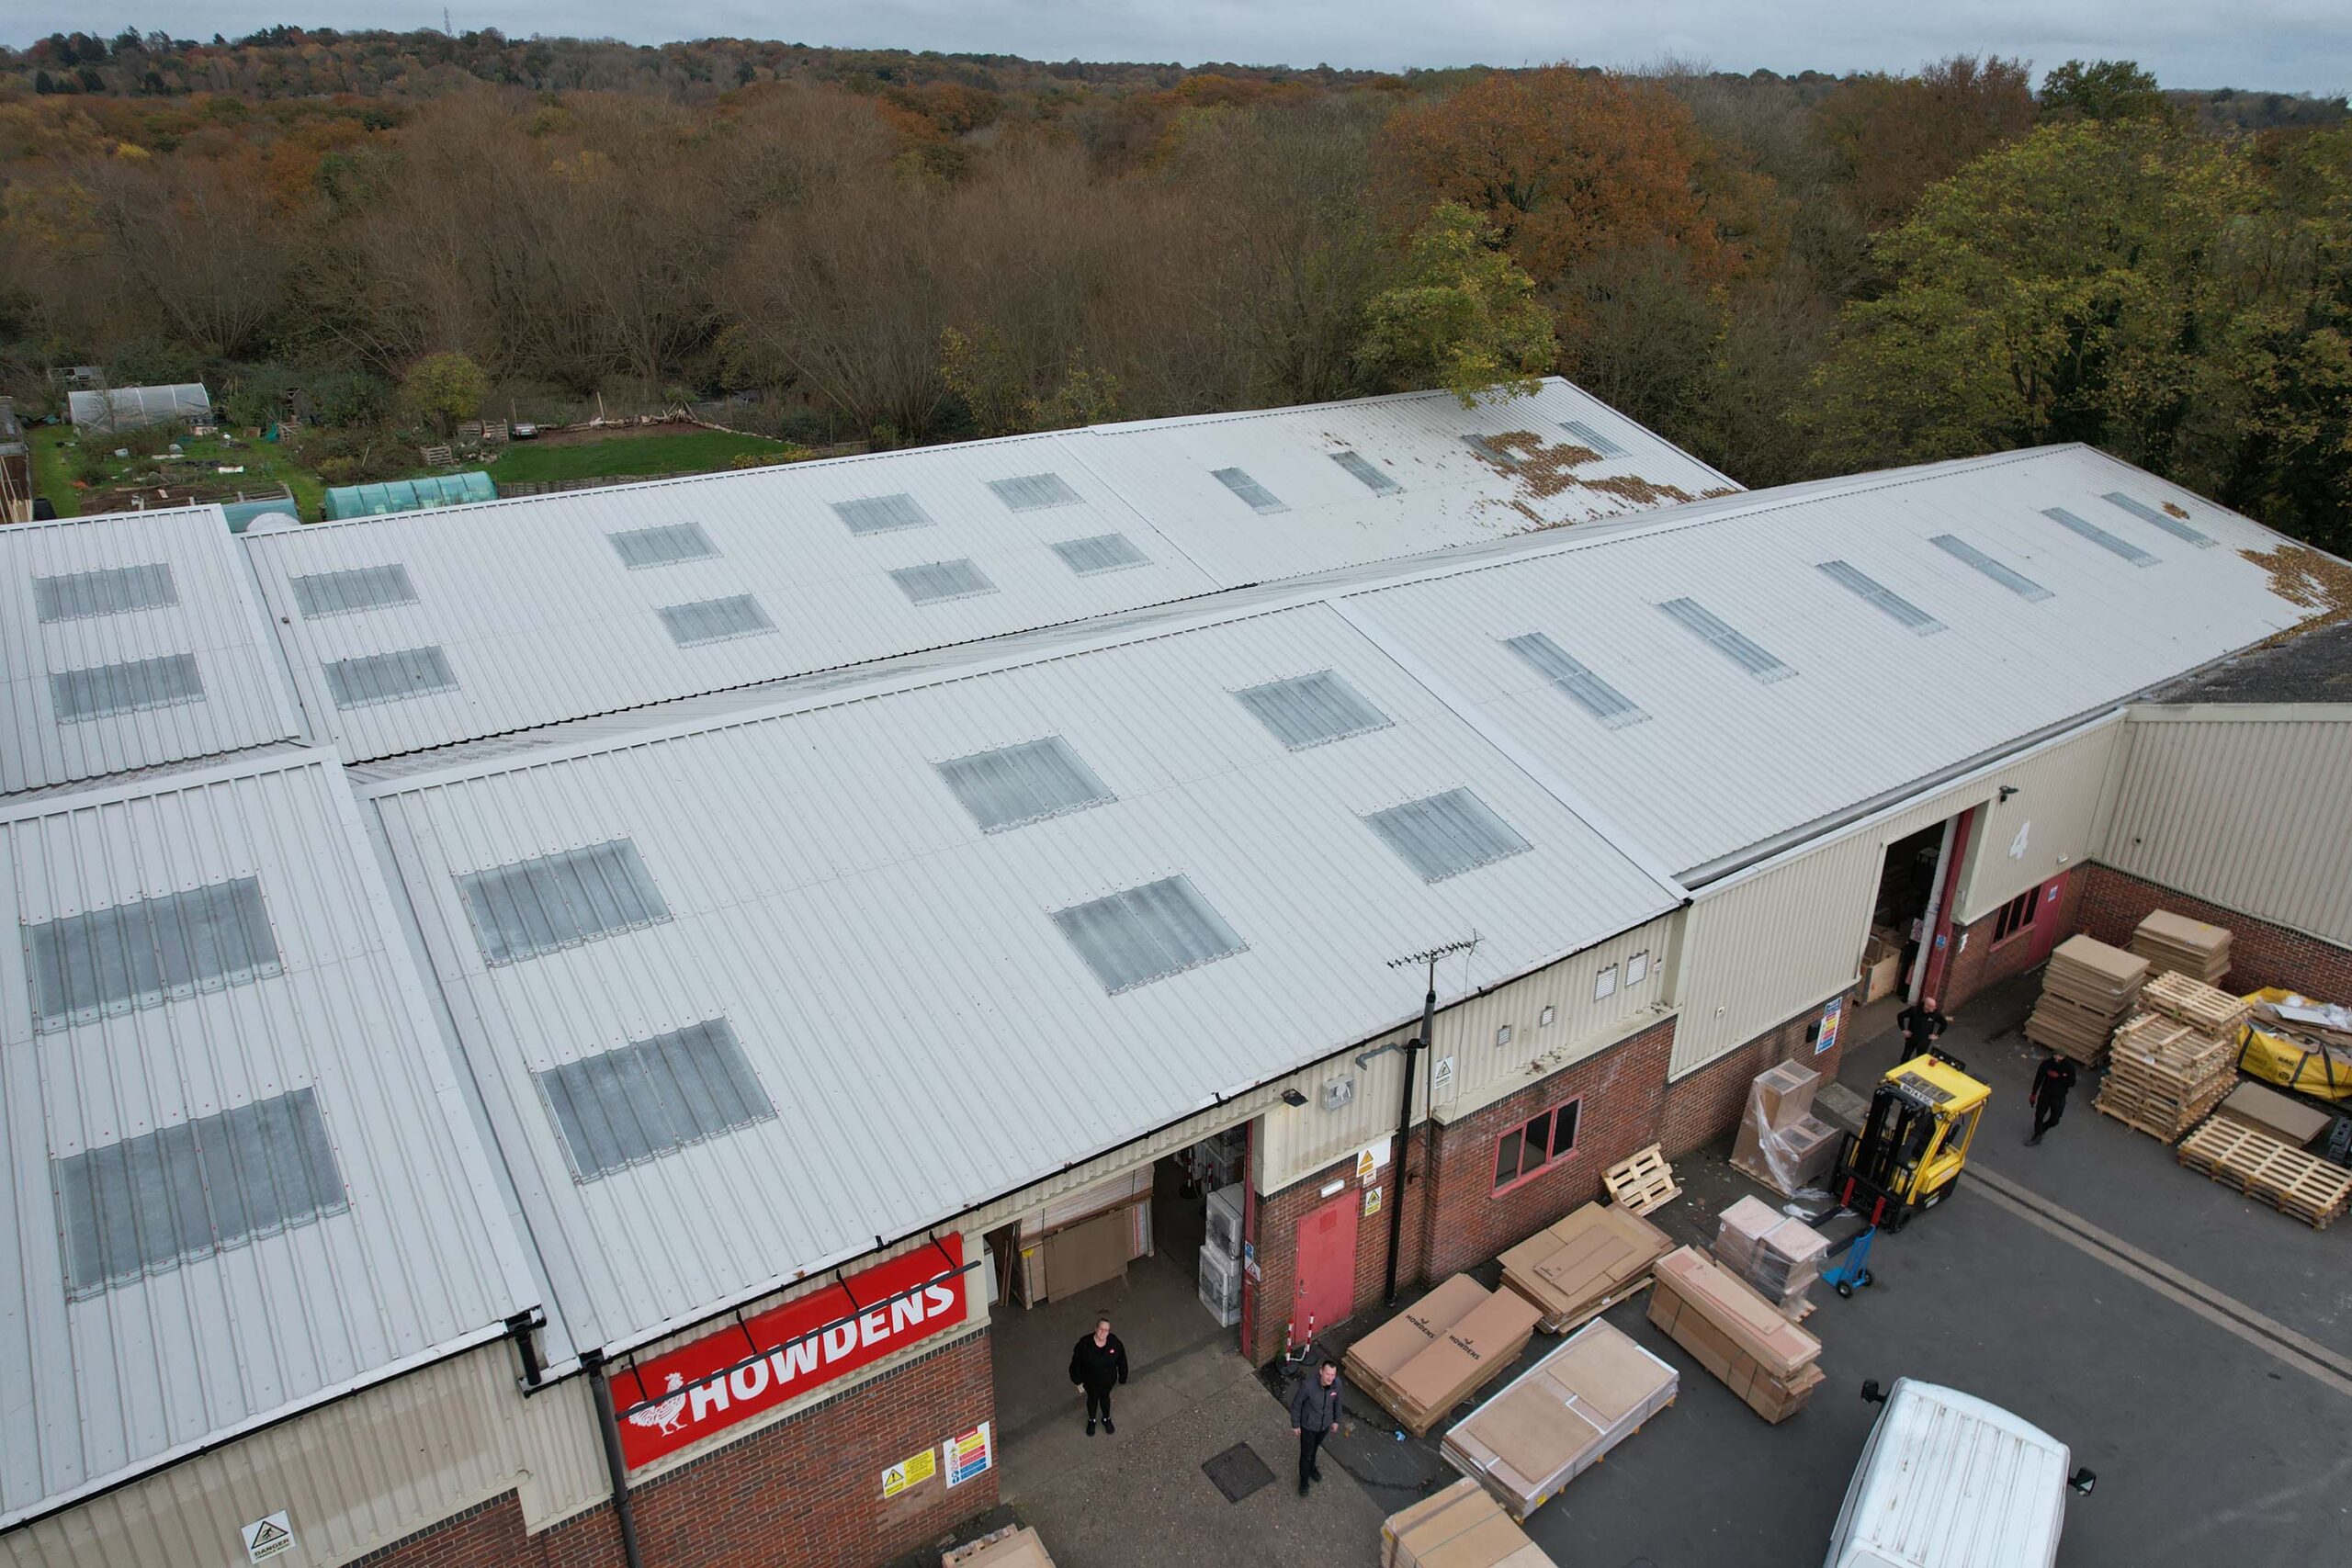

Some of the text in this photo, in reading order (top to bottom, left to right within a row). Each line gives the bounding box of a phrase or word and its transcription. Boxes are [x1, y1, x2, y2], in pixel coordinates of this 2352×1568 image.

[1405, 1314, 1437, 1339] HOWDENS
[686, 1269, 955, 1423] HOWDENS
[1448, 1334, 1481, 1360] HOWDENS
[254, 1538, 289, 1556] DANGER
